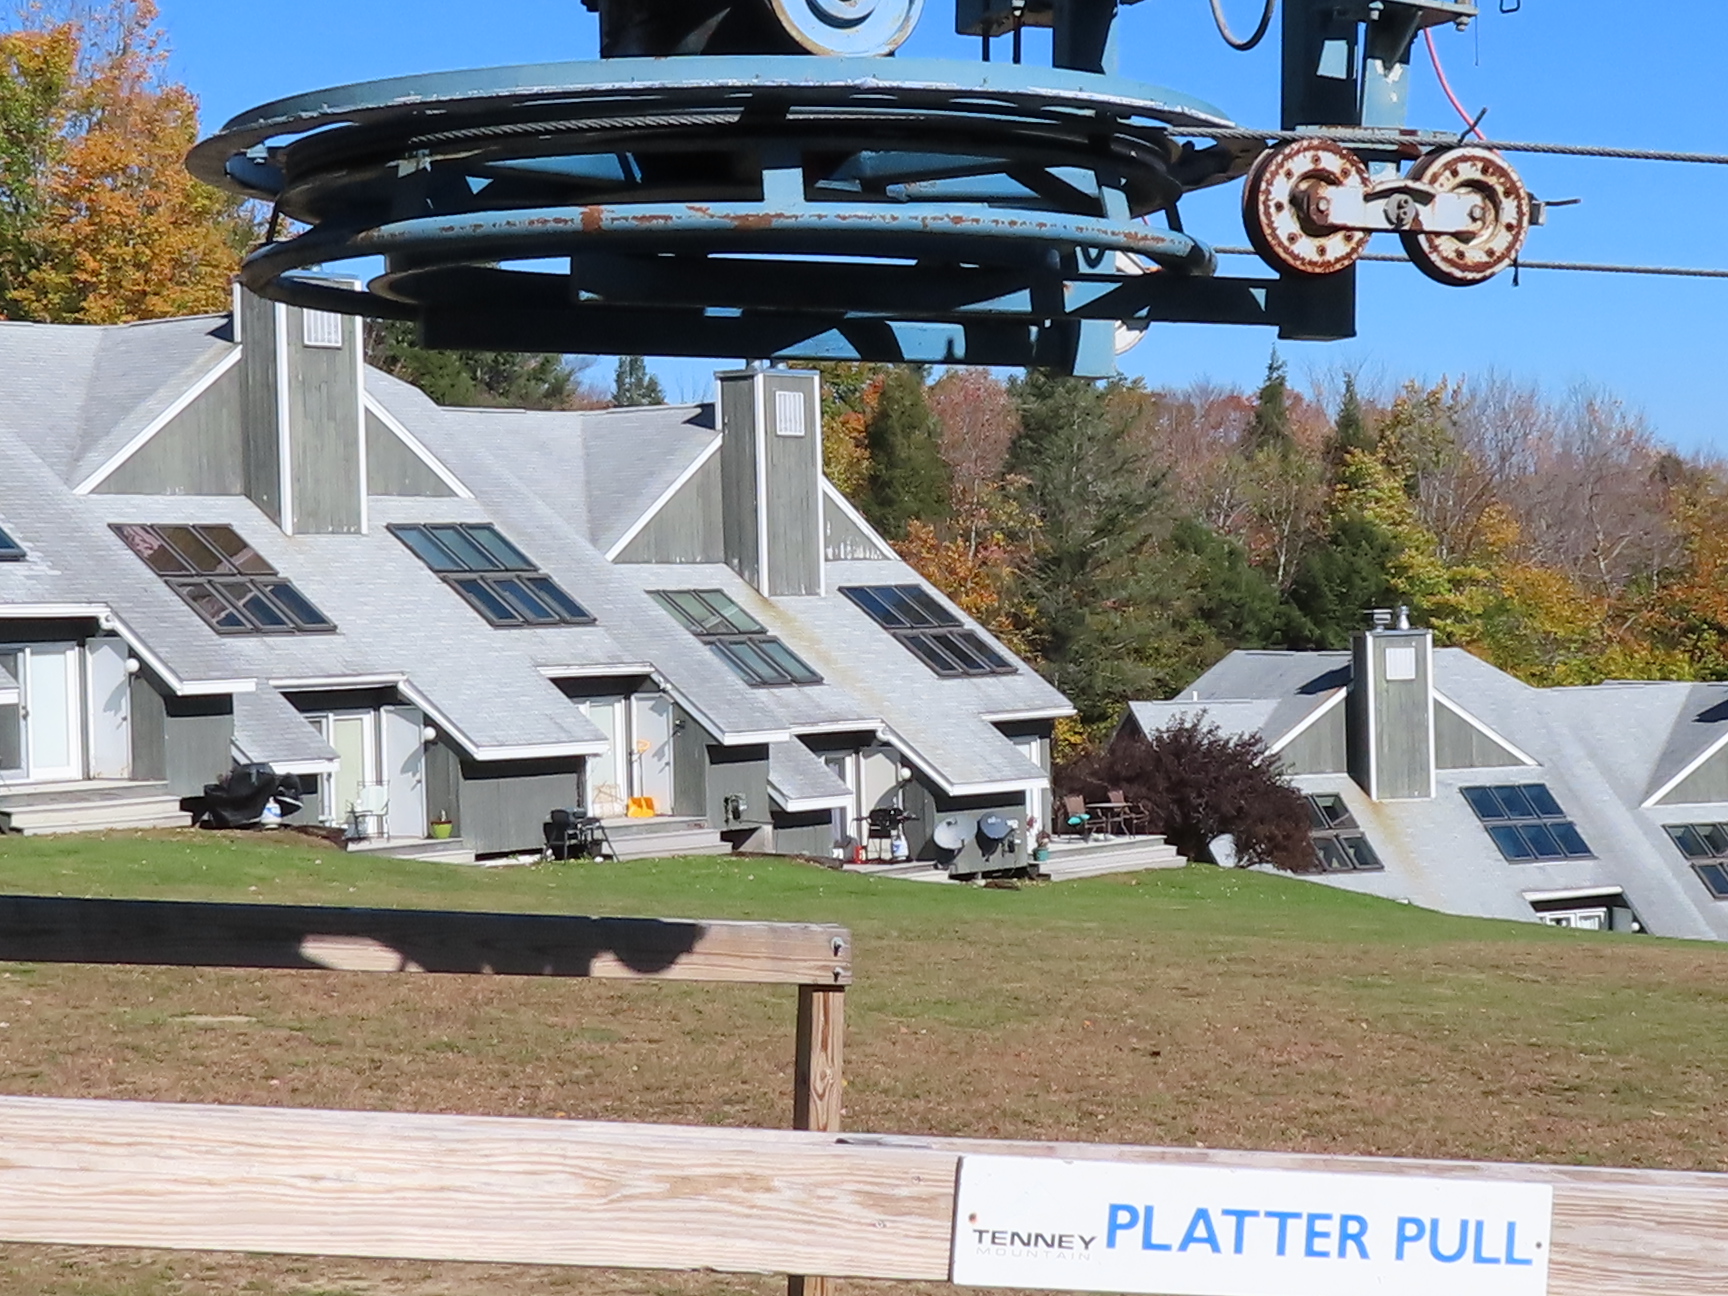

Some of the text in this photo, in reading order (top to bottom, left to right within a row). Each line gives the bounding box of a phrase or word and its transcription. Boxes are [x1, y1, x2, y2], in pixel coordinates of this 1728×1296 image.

[973, 1230, 1095, 1249] TENNEY
[1107, 1204, 1532, 1265] PLATTER PULL
[975, 1246, 1091, 1261] MOUNTAIN
